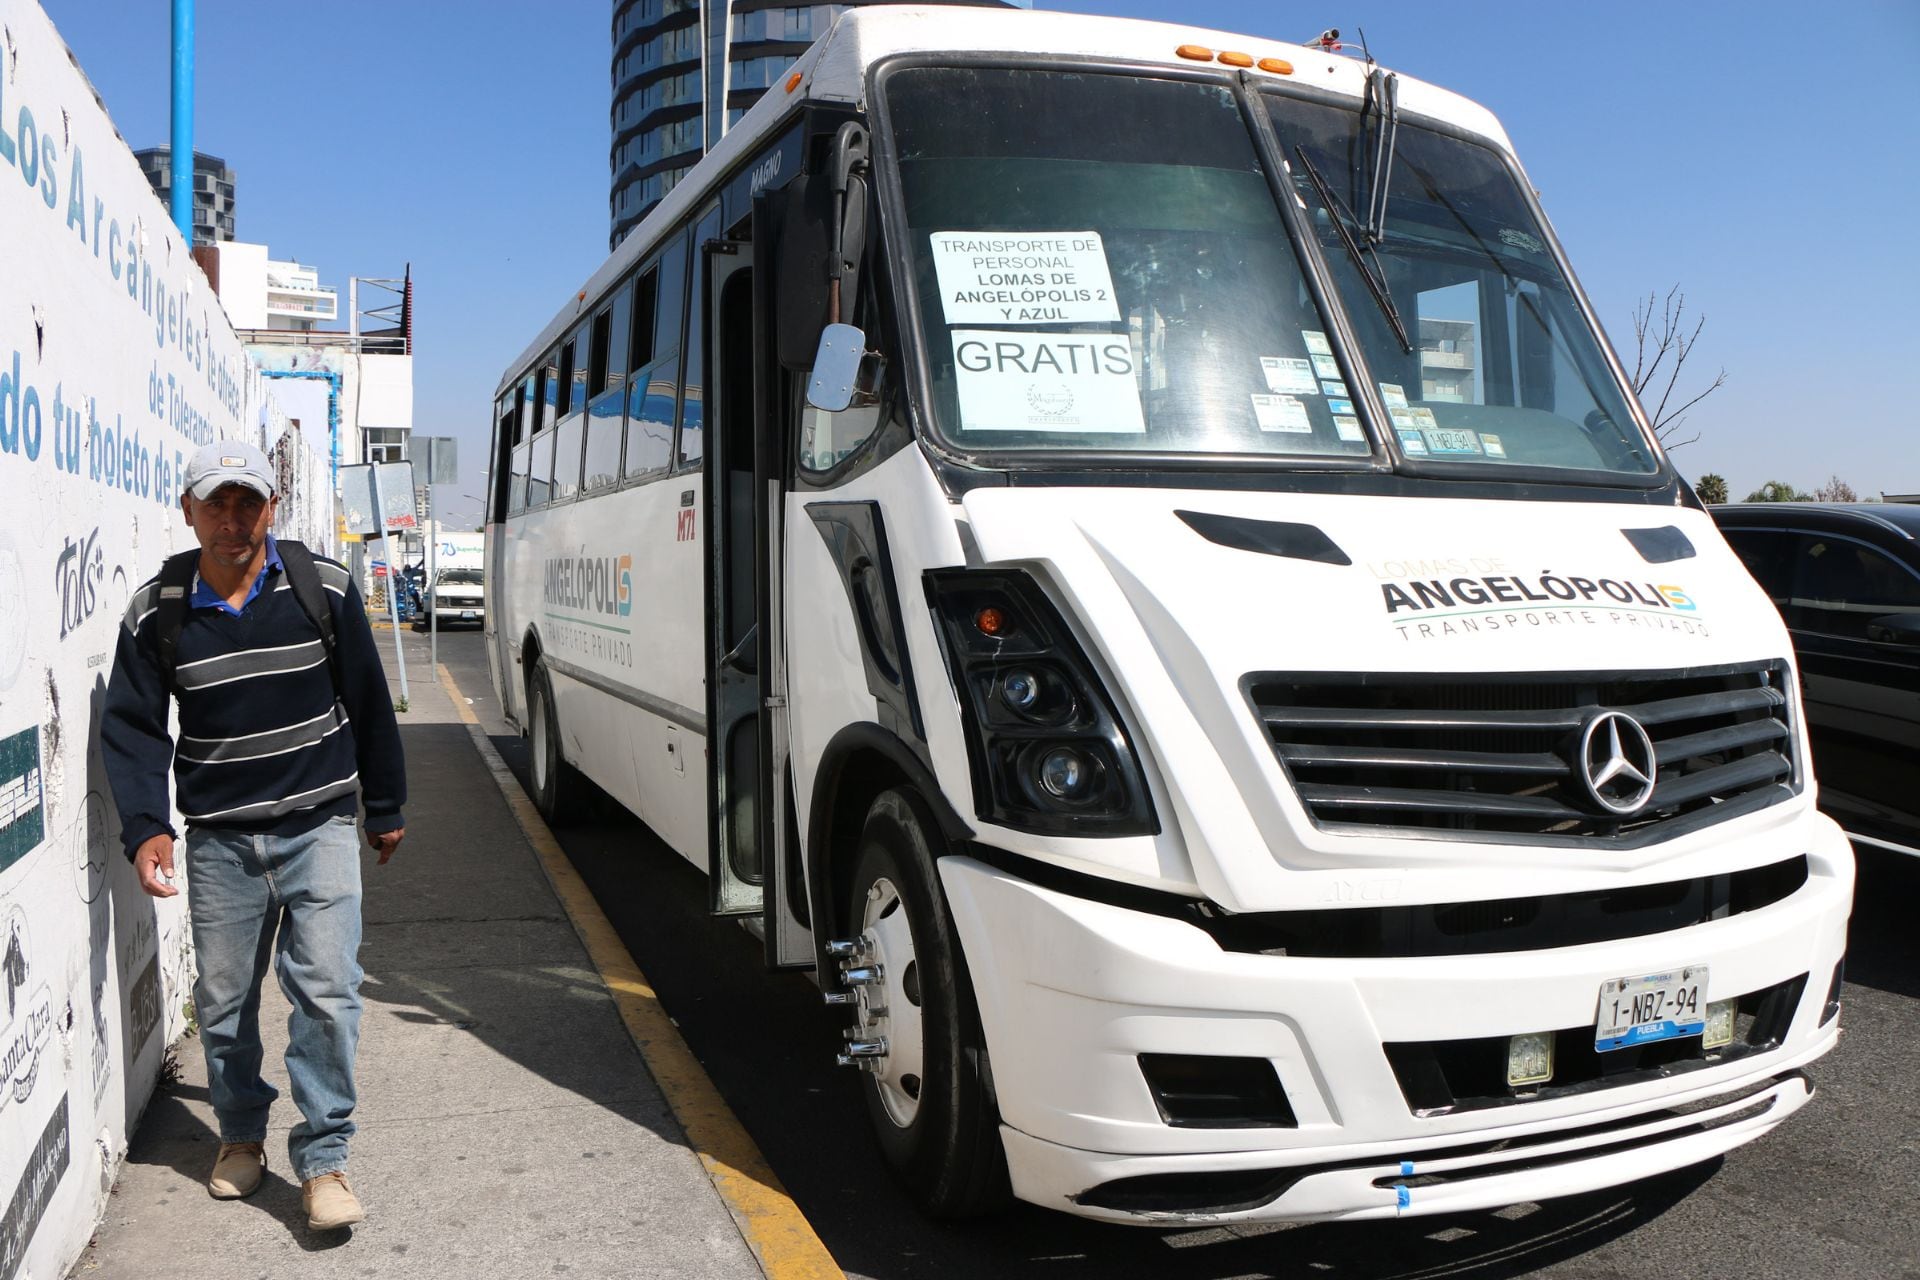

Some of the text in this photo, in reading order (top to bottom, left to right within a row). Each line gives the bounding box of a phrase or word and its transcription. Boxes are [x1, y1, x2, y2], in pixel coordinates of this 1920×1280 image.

[751, 149, 782, 196] MAGNO
[0, 44, 57, 209] Los
[66, 144, 201, 372] Arcángeles
[207, 336, 216, 391] te
[940, 239, 1098, 253] TRANSPORTE DE
[973, 257, 1074, 269] PERSONAL
[954, 288, 1107, 303] ANGELÓPOLIS 2
[978, 273, 1077, 286] LOMAS DE
[1001, 308, 1069, 320] Y AZUL
[956, 341, 1133, 375] GRATIS
[149, 359, 213, 447] de Tolerancia
[53, 381, 80, 475] tu
[90, 397, 149, 499] boleto
[155, 440, 171, 507] de
[175, 450, 187, 510] E
[677, 509, 695, 541] M71
[544, 544, 632, 617] ANGELÓPOLIS
[1367, 557, 1514, 580] LOMAS DE
[1381, 569, 1697, 613] ANGELÓPOLIS
[1395, 611, 1711, 641] TRANSPORTE PRIVADO
[544, 621, 632, 668] TRANSPORTE PRIVADO
[1612, 985, 1698, 1027] 1-NBZ-94
[26, 1000, 50, 1052] Clara
[1637, 1022, 1665, 1035] PUEBLA
